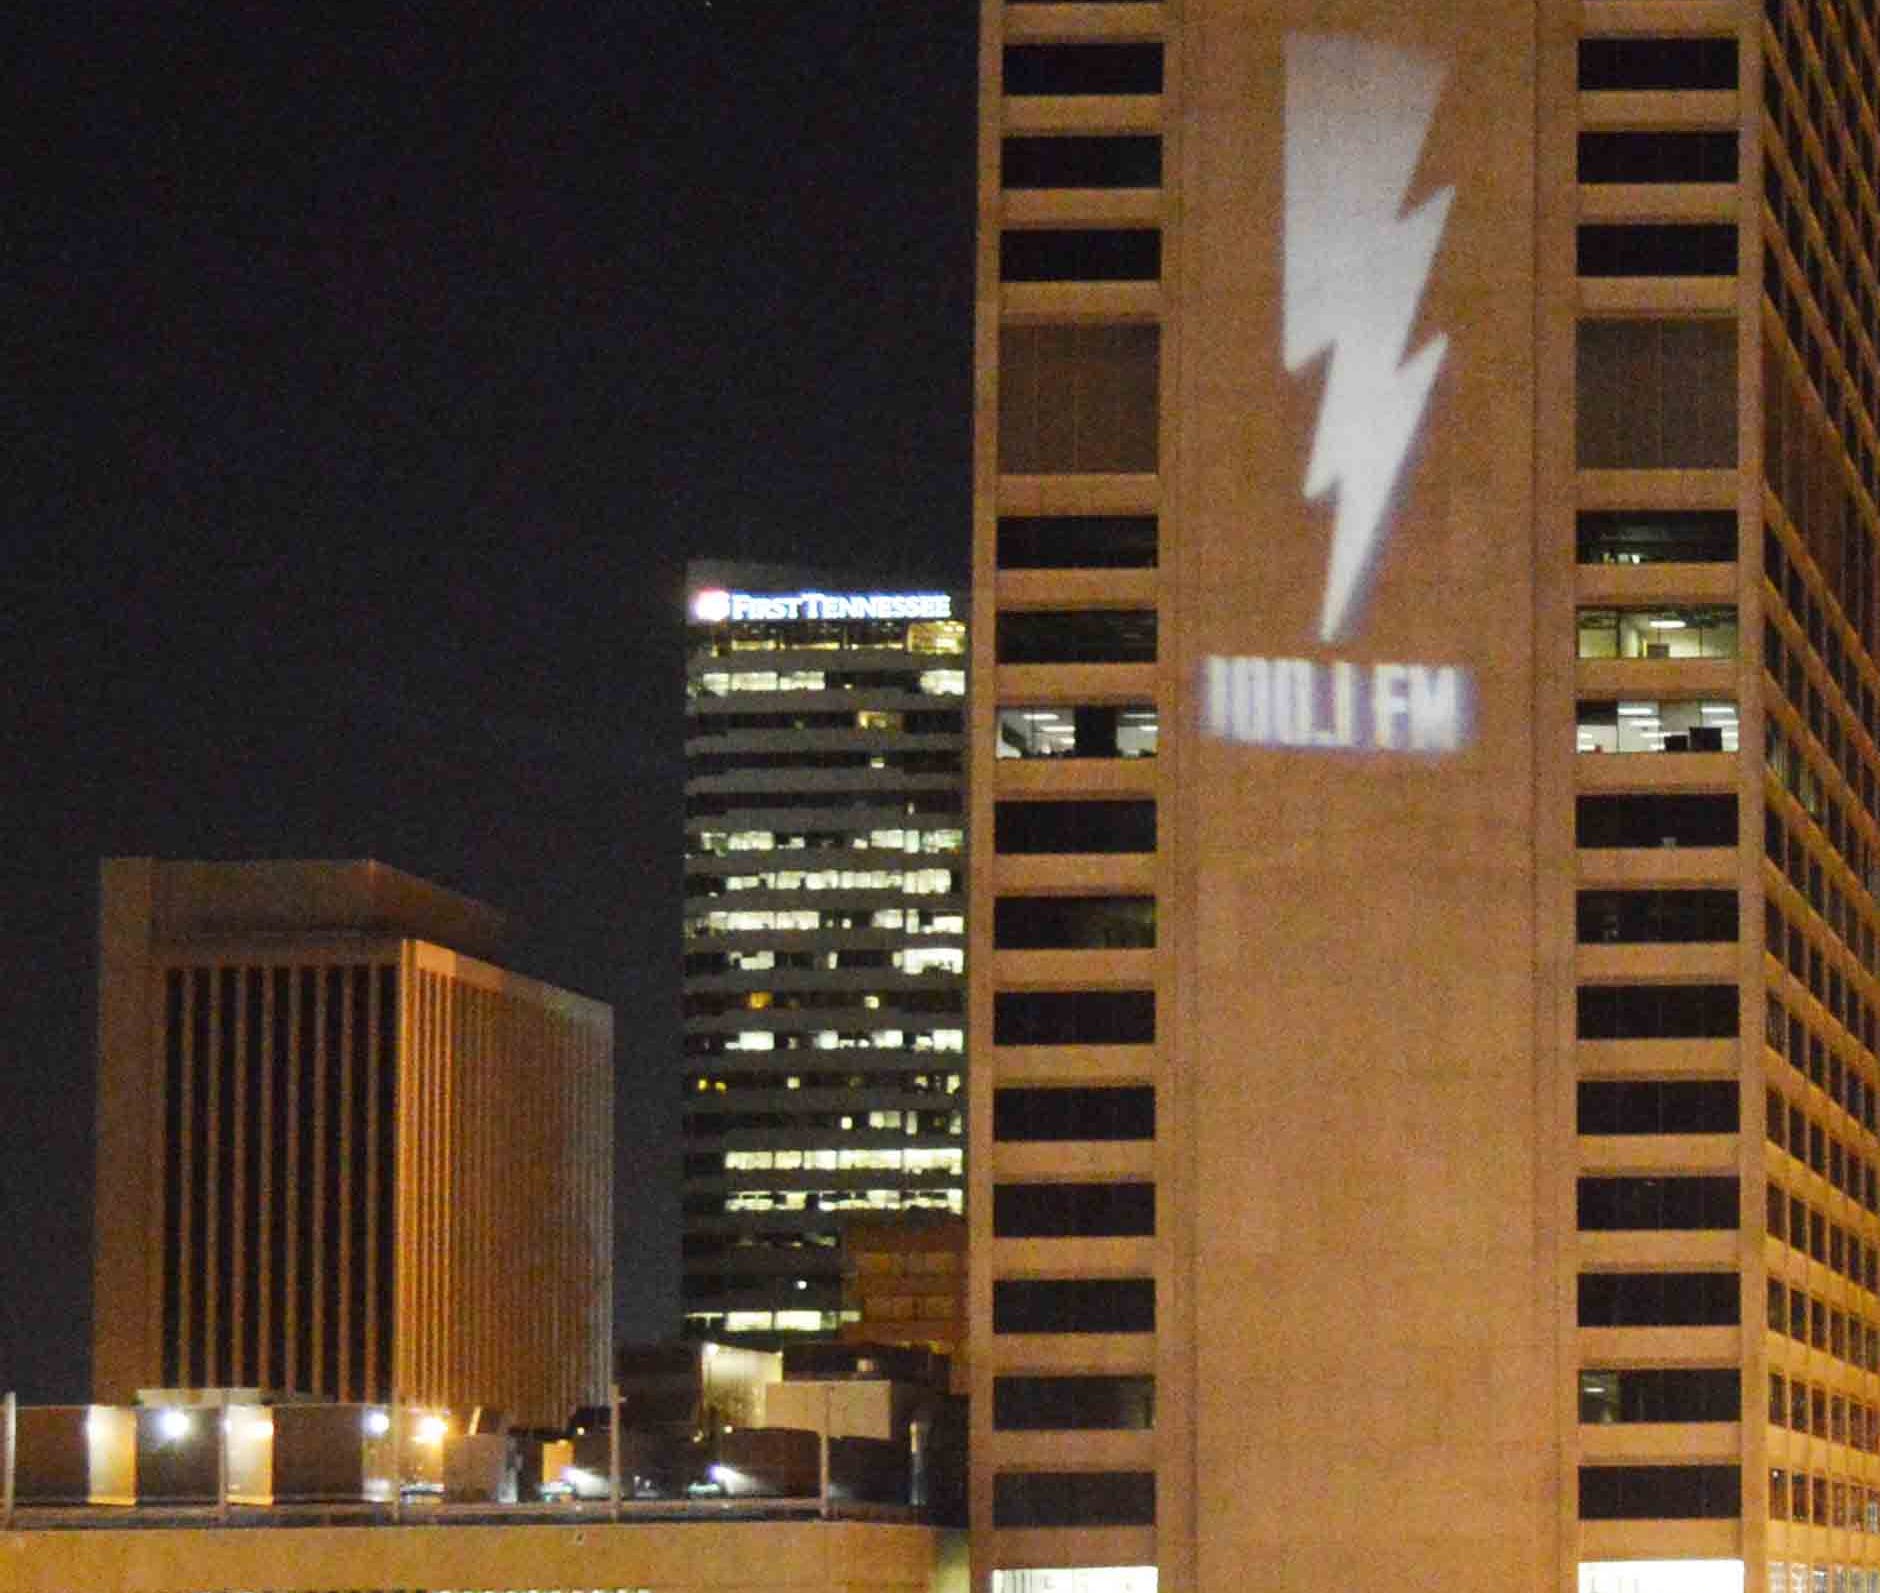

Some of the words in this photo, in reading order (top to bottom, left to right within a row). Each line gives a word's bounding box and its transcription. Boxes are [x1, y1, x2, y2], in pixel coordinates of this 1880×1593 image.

[731, 594, 800, 619] FIRST
[801, 592, 951, 618] TENNESSEE
[1373, 662, 1462, 751] FM
